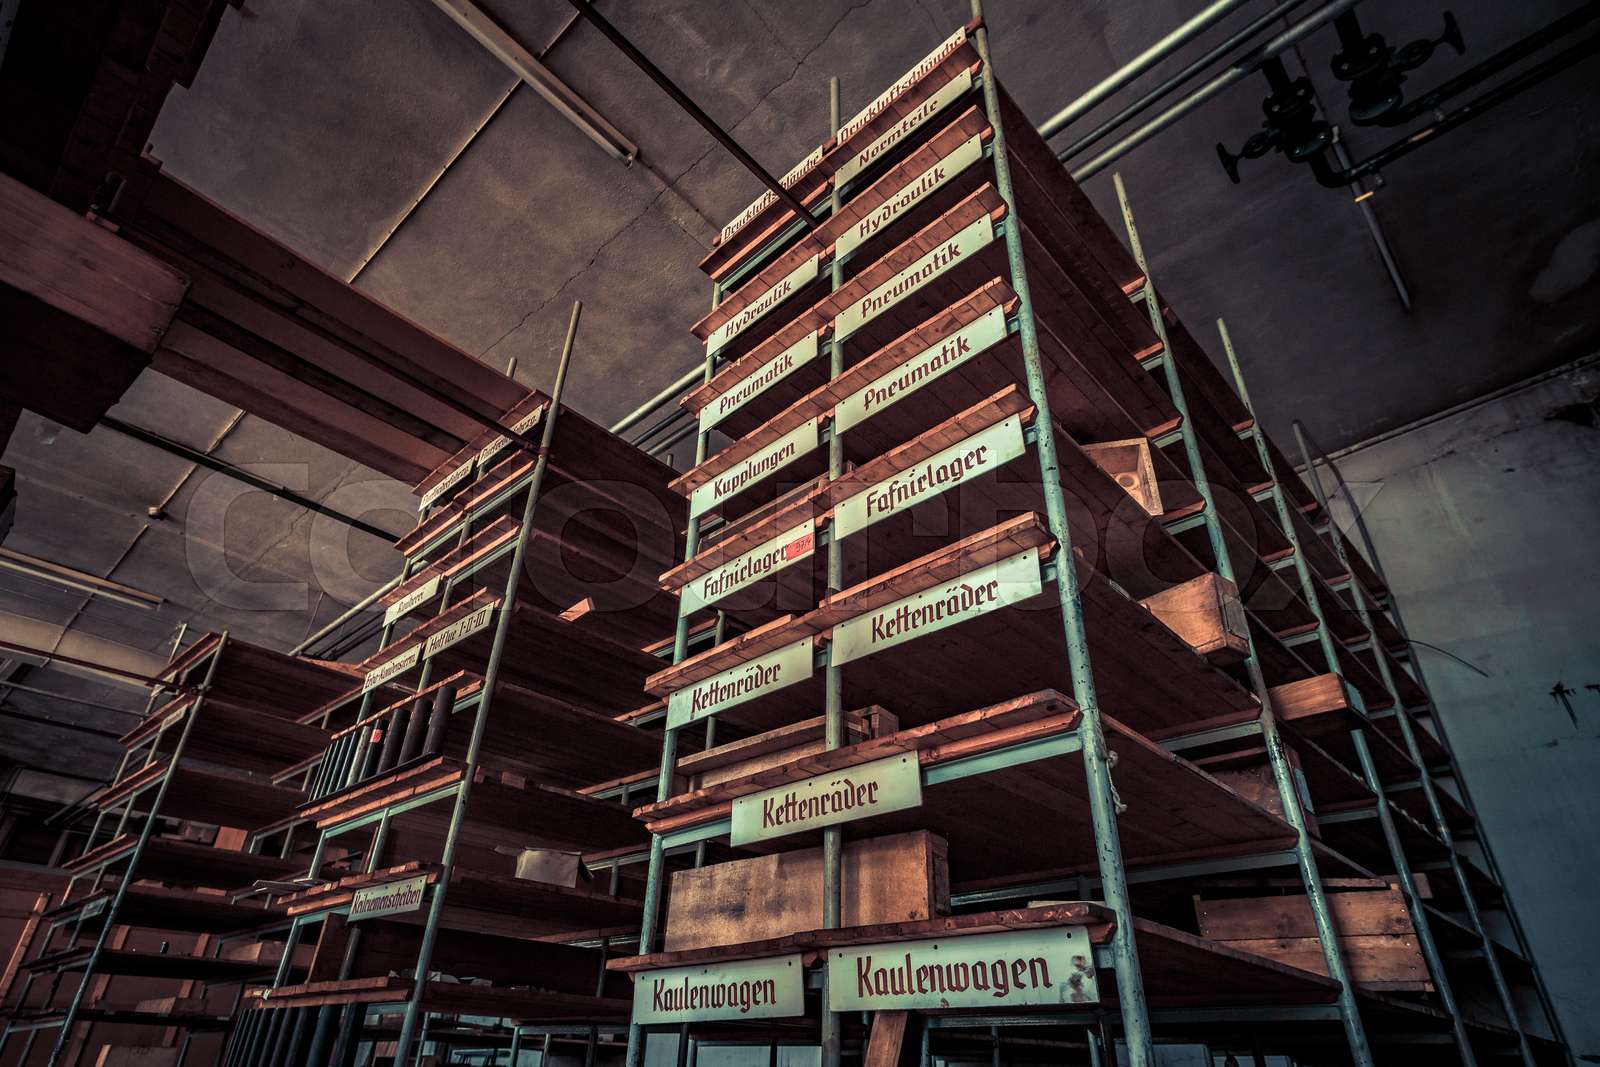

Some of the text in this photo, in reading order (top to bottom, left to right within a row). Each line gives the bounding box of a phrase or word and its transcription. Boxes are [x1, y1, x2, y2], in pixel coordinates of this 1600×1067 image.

[859, 99, 938, 167] Normteile
[723, 153, 820, 240] Druckluftsläuche
[859, 168, 946, 238] Hydraulik
[725, 280, 792, 338] Hydraulik
[861, 243, 961, 318] Pneumatik
[719, 354, 794, 415] Pneumatik
[863, 335, 970, 411] Pneumatik
[713, 441, 796, 500] Kupplungen
[866, 443, 988, 518] Fafnirlager
[703, 545, 788, 600] Fafnirlager
[872, 577, 998, 644] Kettenräder
[690, 660, 781, 714] Kettenräder
[762, 777, 879, 829] Kettenräder
[653, 976, 777, 1014] Kaulenwagen
[857, 953, 1053, 998] Kaulenwagen
